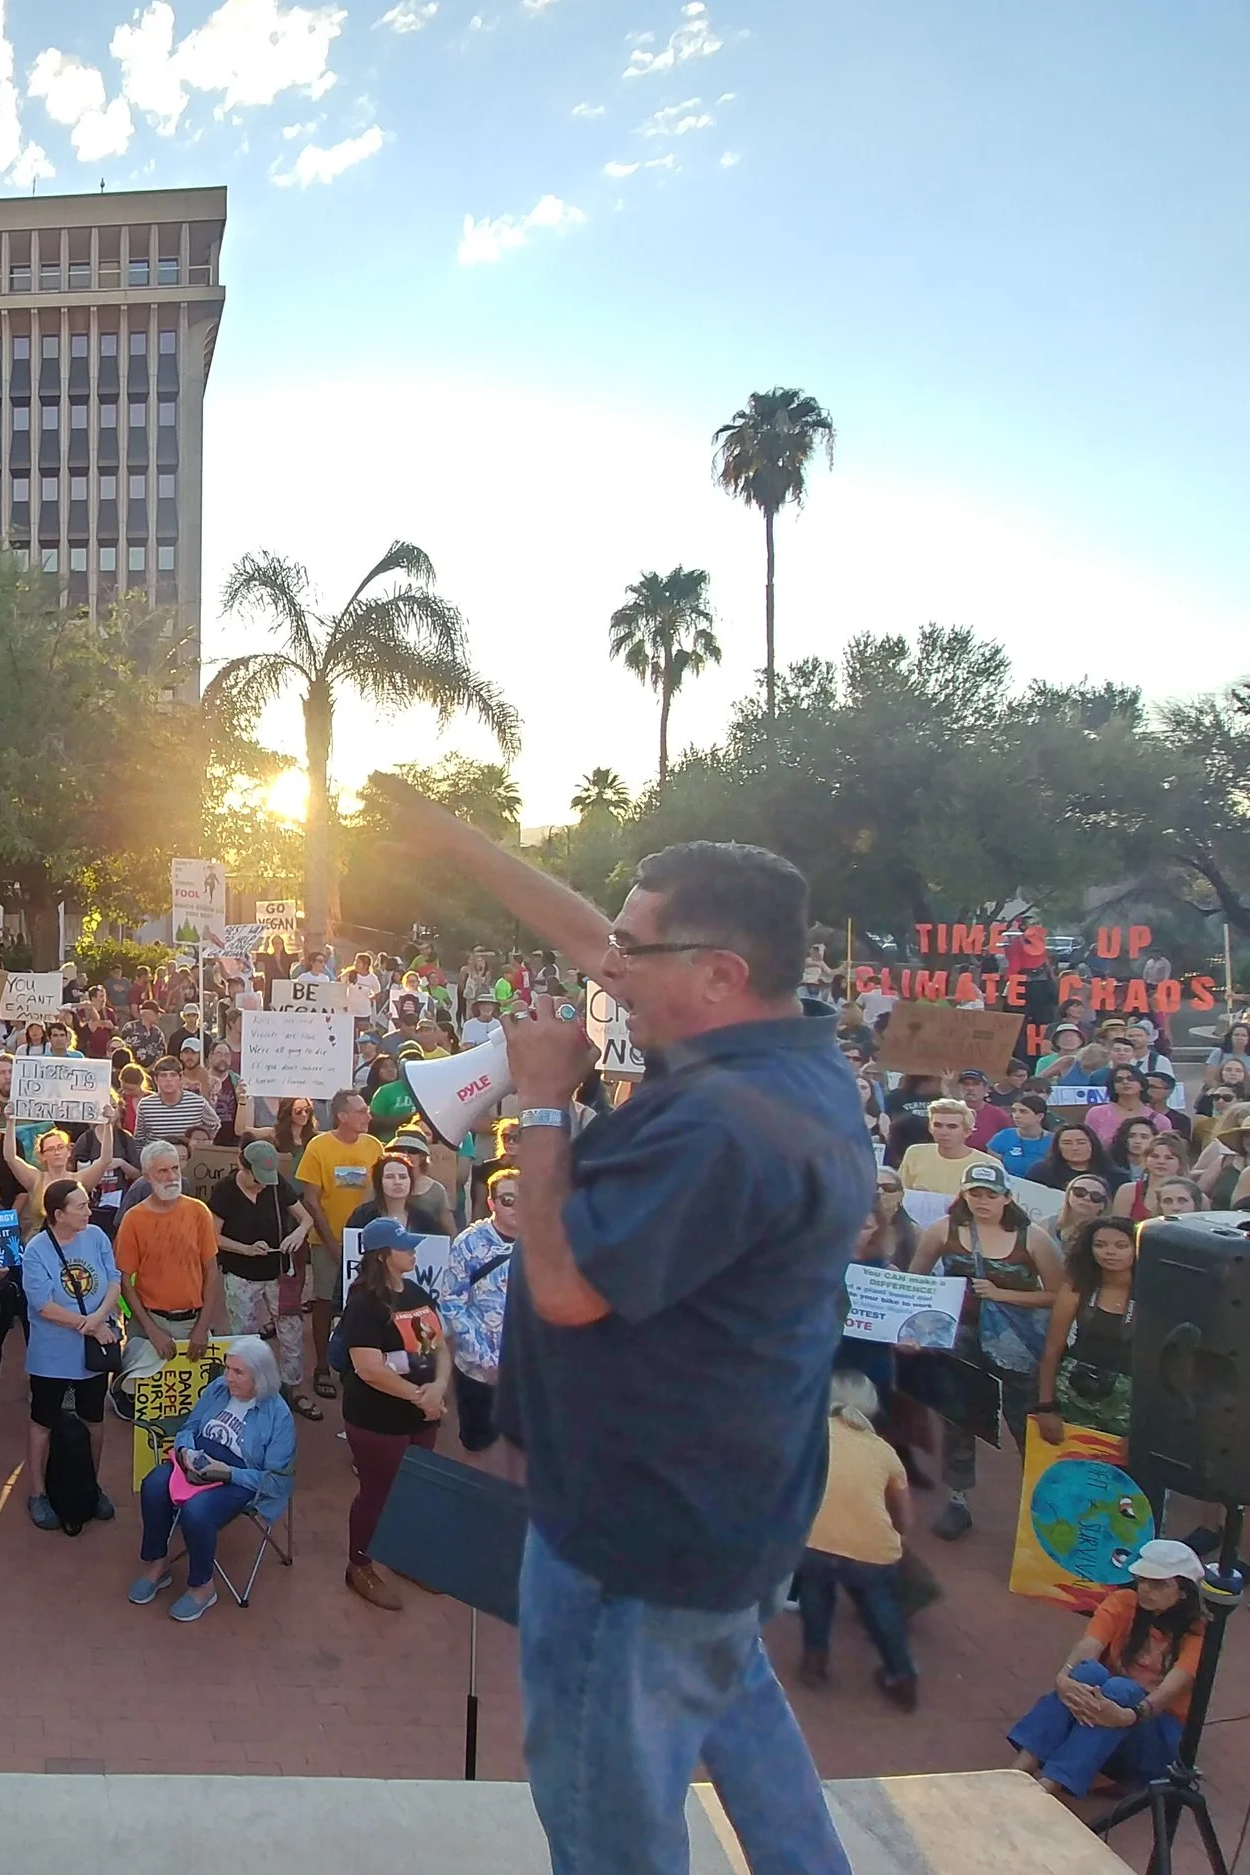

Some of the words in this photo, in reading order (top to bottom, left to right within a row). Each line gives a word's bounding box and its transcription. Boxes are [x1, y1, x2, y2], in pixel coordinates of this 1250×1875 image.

[175, 889, 200, 899] FOOL
[265, 903, 286, 914] GO
[258, 917, 294, 931] VEGAN
[1096, 925, 1154, 960] UP
[6, 976, 36, 993] YOU
[292, 982, 320, 1001] BE
[854, 965, 1028, 1007] CLIMATE
[1059, 976, 1216, 1014] CHAOS
[16, 1011, 55, 1021] MONE
[18, 1079, 43, 1097] NO
[71, 1069, 97, 1091] IS
[456, 1074, 492, 1102] PYLE
[15, 1099, 80, 1120] PLANET
[82, 1101, 98, 1121] B
[193, 1162, 225, 1180] Our
[1, 1229, 10, 1238] IT
[863, 1268, 882, 1277] You
[884, 1272, 907, 1282] CAN
[909, 1277, 938, 1286] make
[869, 1278, 938, 1295] DIFFERENCE!
[860, 1294, 879, 1303] your
[881, 1298, 900, 1306] bike
[850, 1308, 887, 1320] OTEST
[845, 1318, 873, 1331] OTE
[136, 1376, 150, 1422] LOW
